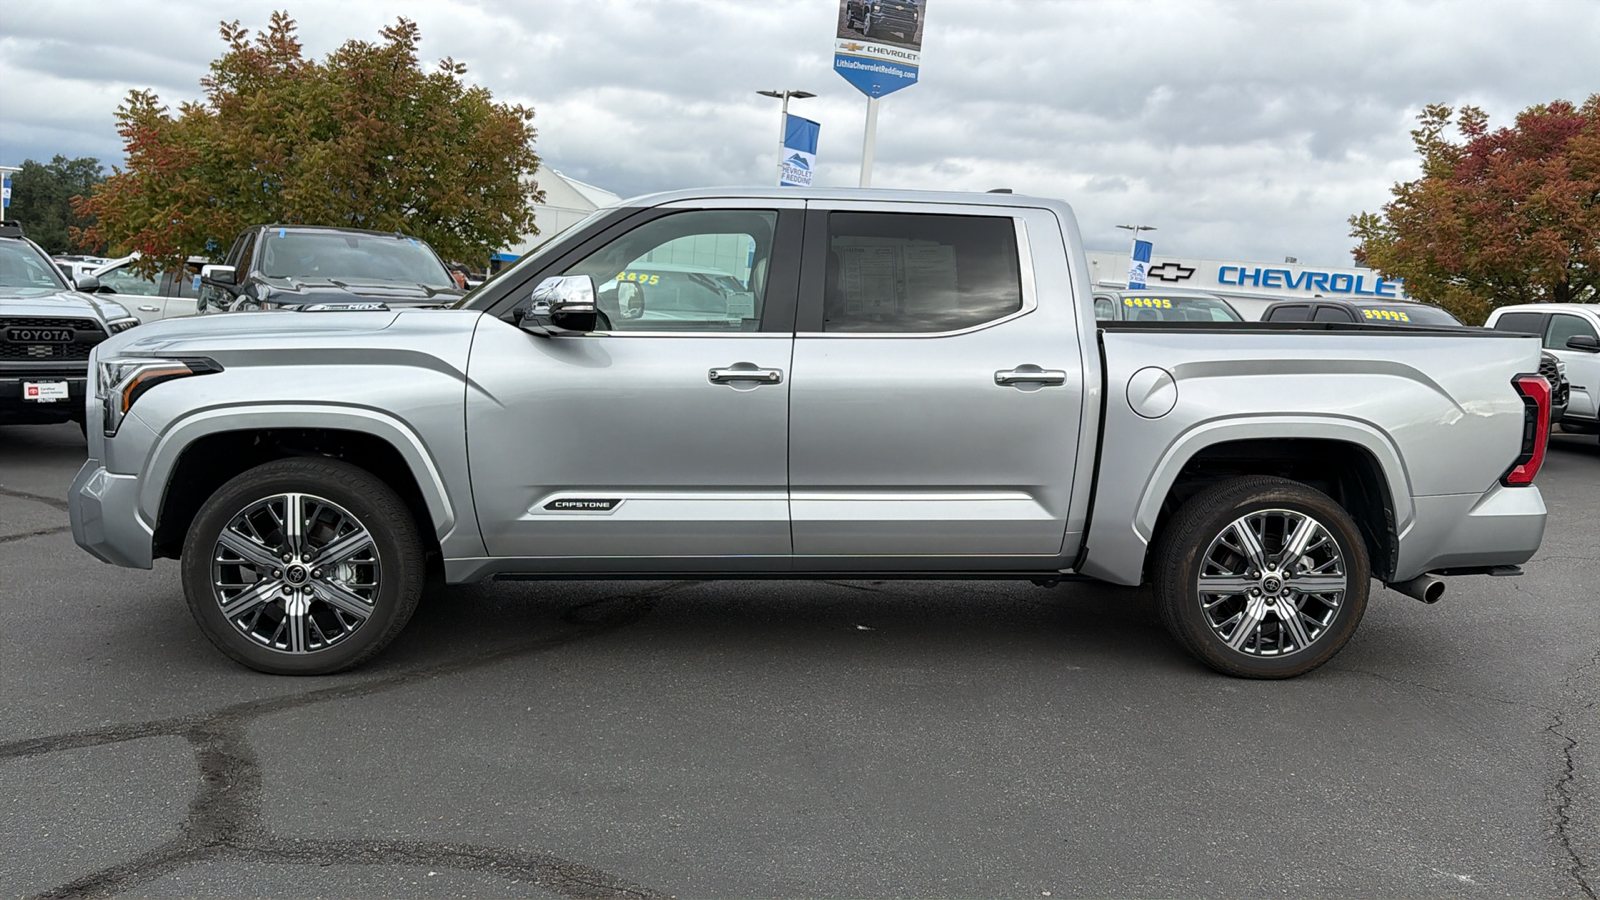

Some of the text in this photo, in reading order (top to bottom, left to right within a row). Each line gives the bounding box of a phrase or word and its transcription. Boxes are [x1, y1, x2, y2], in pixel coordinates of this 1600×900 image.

[867, 45, 917, 60] CHEVROLET
[836, 59, 916, 79] LithiaChevroletRedding.com
[782, 166, 812, 178] HEVROLET
[786, 173, 811, 185] REDDING
[1218, 266, 1408, 298] CHEVROLE
[1124, 298, 1172, 309] 44495
[1362, 309, 1410, 323] 39995
[11, 330, 70, 340] TOYOTA
